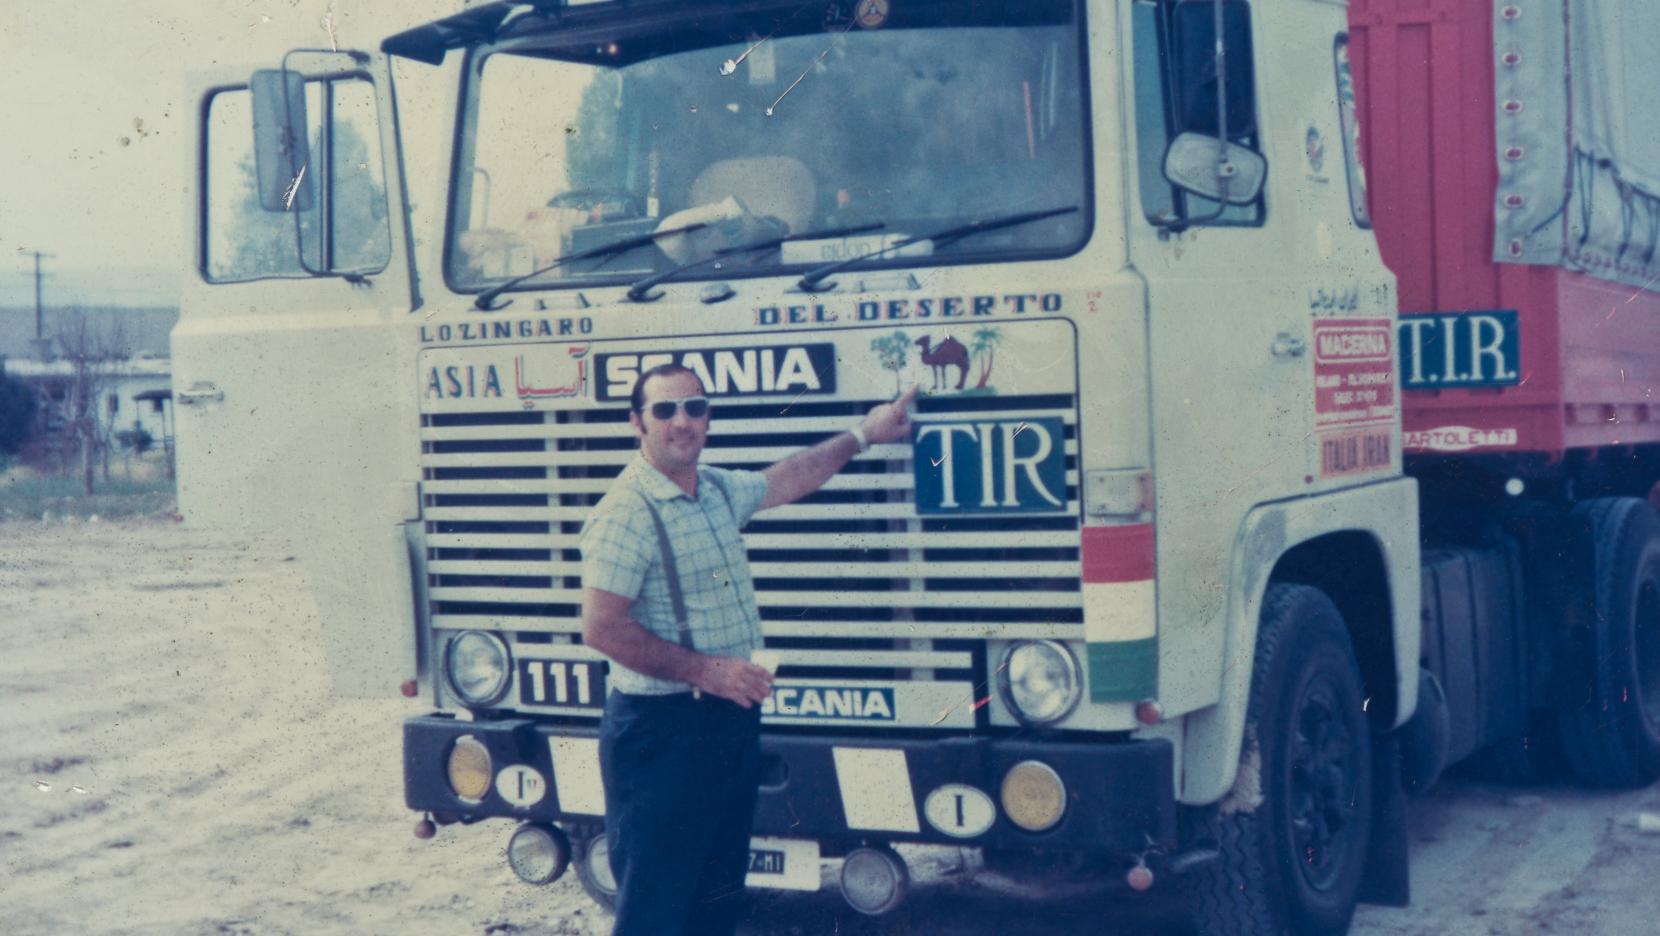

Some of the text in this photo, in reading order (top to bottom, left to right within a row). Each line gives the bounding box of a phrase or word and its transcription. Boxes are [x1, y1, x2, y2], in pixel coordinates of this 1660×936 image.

[755, 293, 1062, 326] DEL DESERTO
[1398, 315, 1518, 384] T.I.R.
[427, 364, 503, 399] ASIA
[915, 421, 1062, 508] TIR
[528, 661, 590, 705] 111
[955, 794, 964, 828] I
